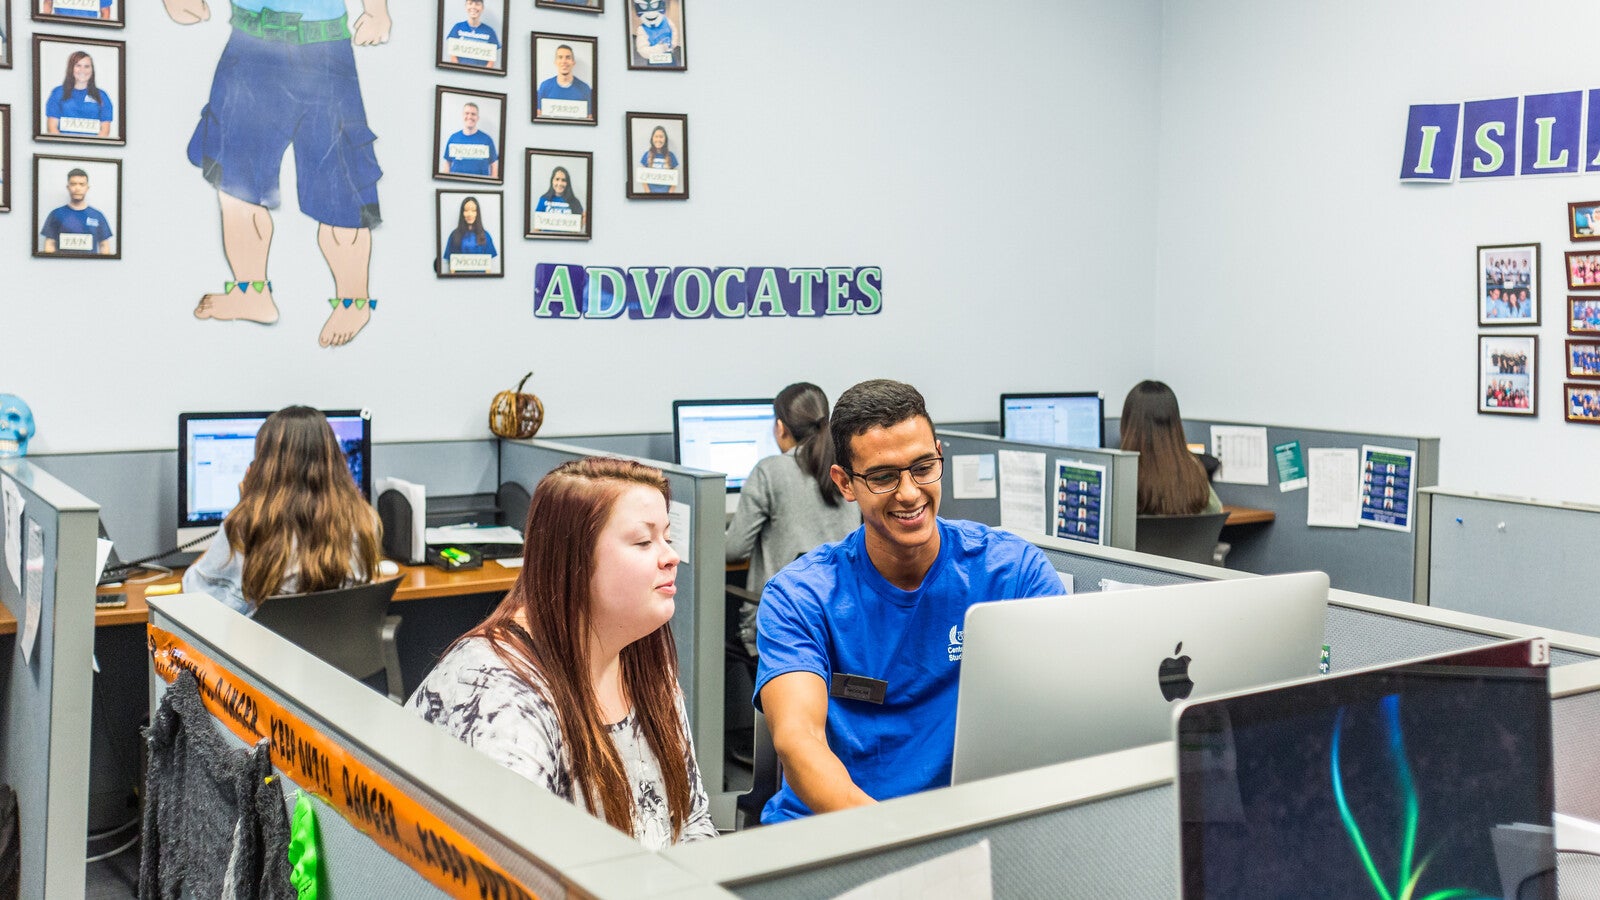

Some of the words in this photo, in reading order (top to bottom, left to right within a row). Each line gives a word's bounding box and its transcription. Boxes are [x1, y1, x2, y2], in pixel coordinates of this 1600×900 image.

[1413, 116, 1600, 174] ISL
[453, 256, 490, 267] NICOLE
[534, 265, 882, 318] ADVOCATES
[270, 714, 296, 768] KEEP
